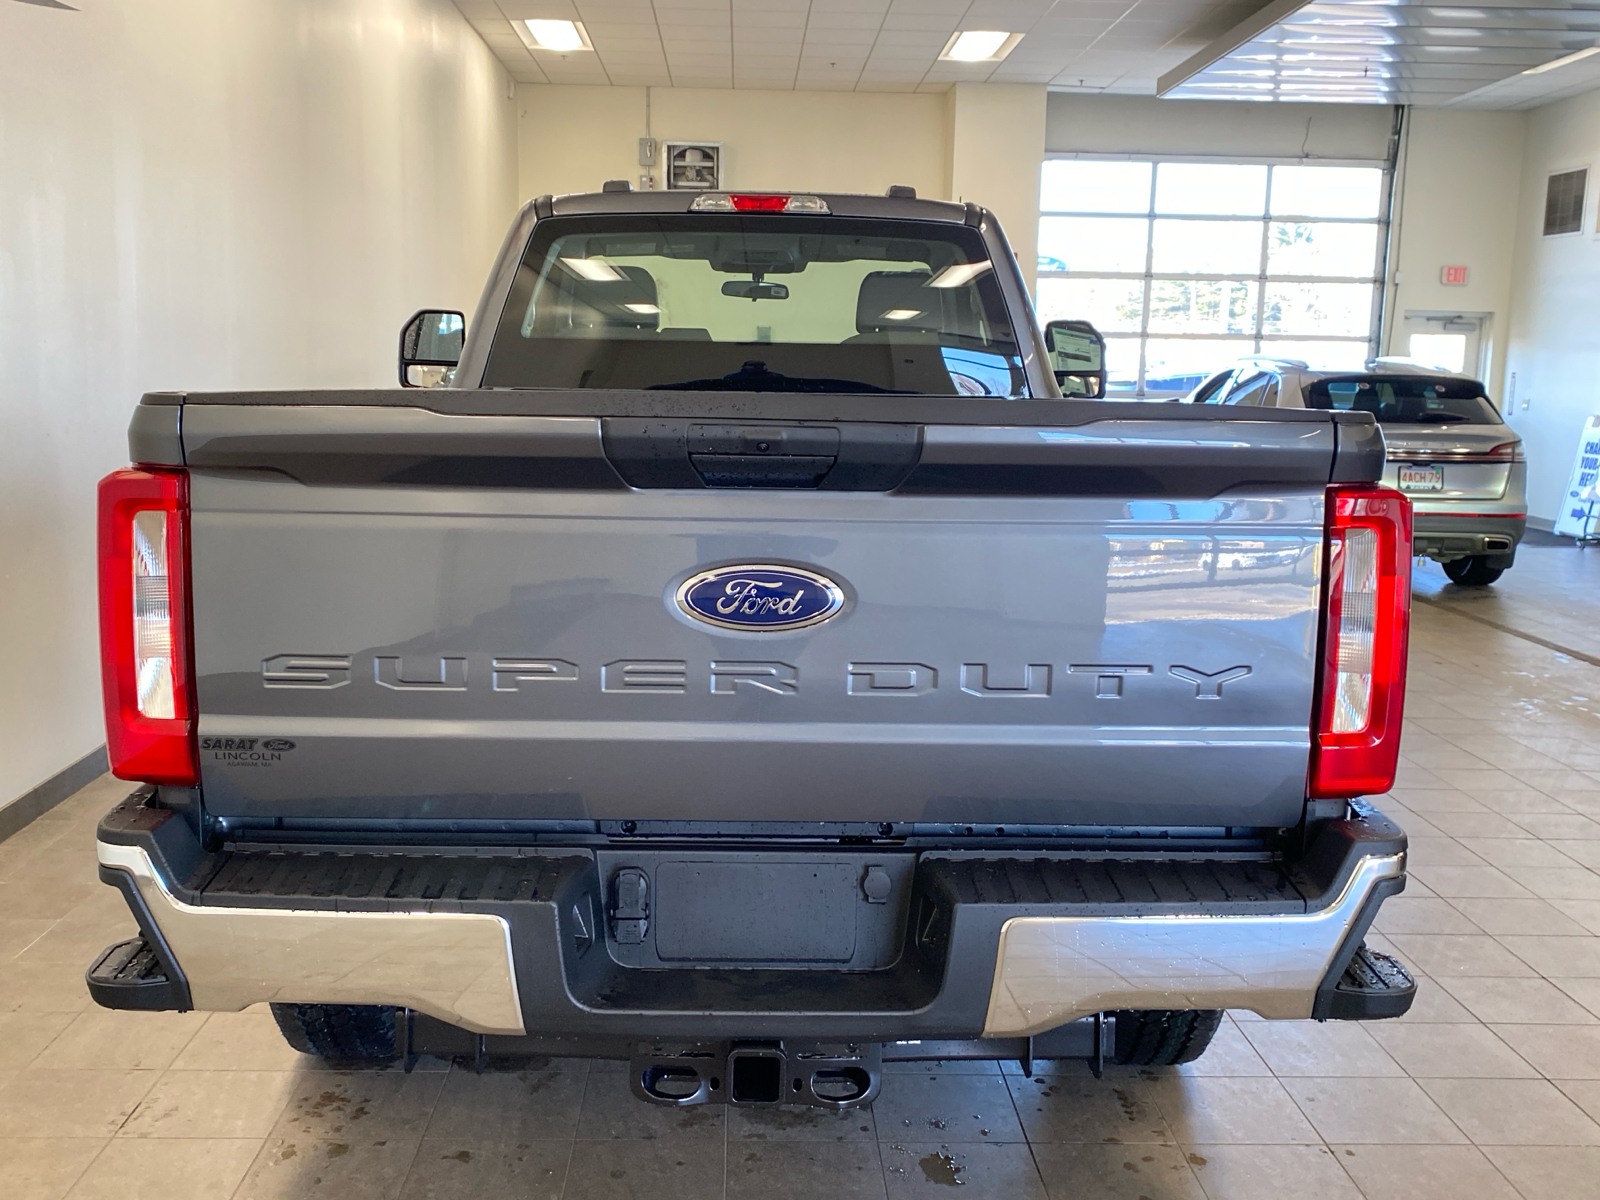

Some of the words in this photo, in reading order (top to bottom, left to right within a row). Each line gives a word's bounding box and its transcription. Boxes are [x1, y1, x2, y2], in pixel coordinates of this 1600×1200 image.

[1446, 266, 1467, 283] EXIT
[716, 579, 805, 615] Ford
[262, 653, 797, 694] SUPER
[847, 662, 1253, 699] DUTY
[201, 737, 258, 751] SARAT
[214, 752, 281, 761] LINCOLN
